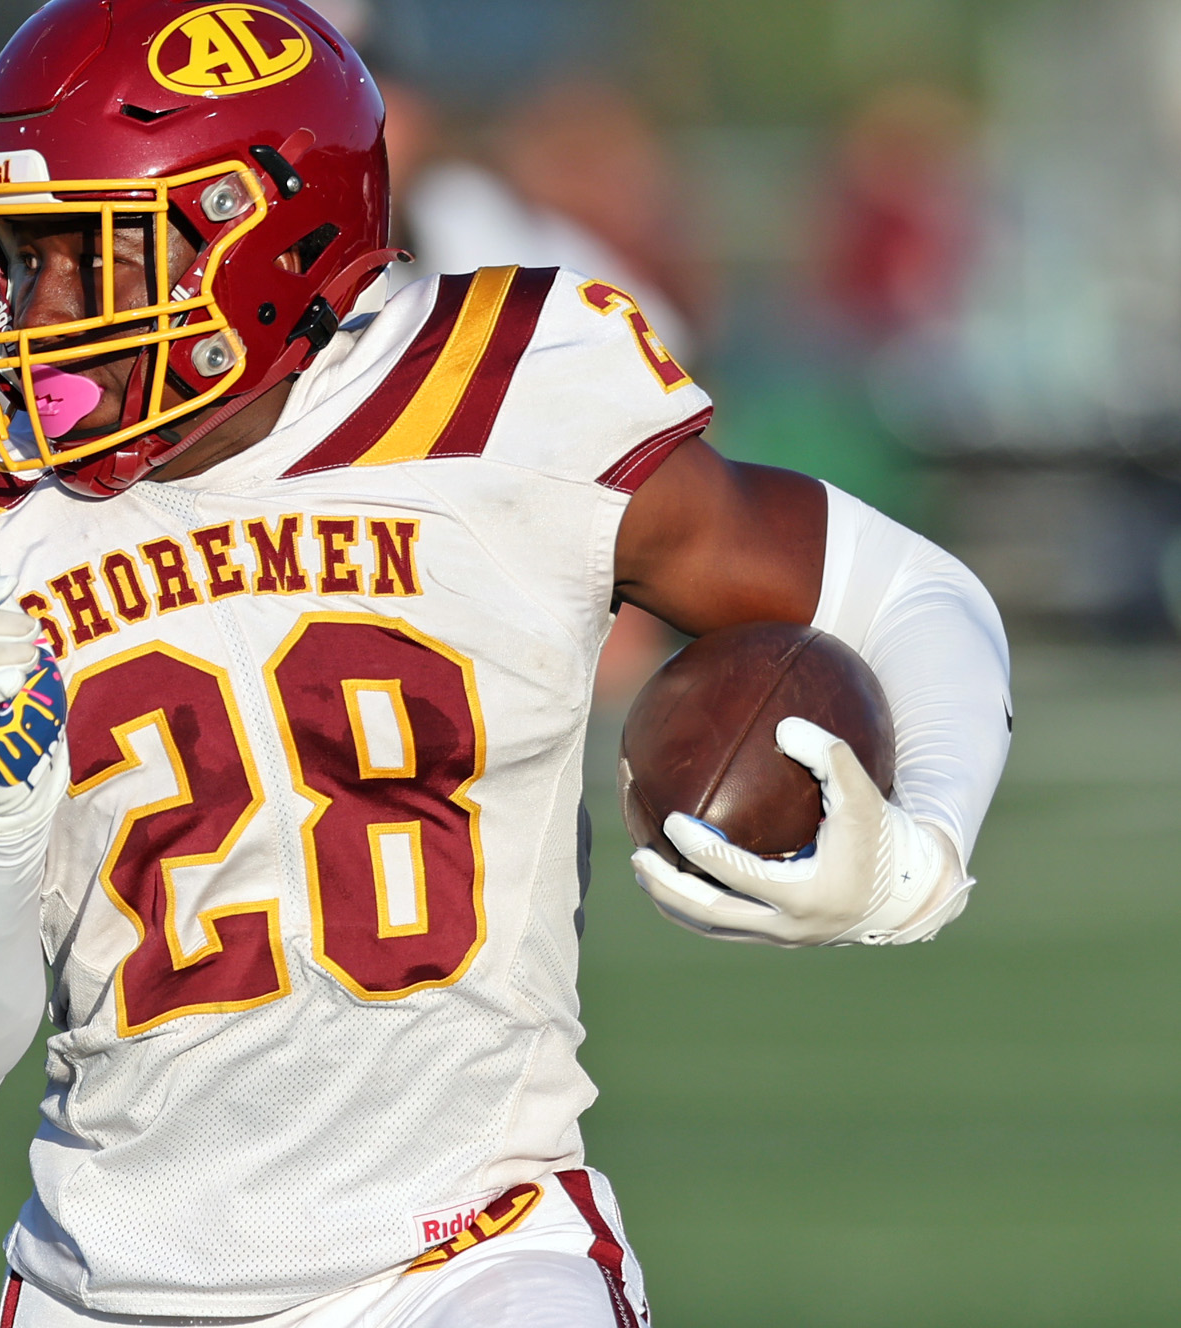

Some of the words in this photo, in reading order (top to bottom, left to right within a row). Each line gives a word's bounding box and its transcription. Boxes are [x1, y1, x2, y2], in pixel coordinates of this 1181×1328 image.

[166, 10, 303, 86] AL
[17, 512, 424, 662] SHOREMEN
[67, 610, 488, 1038] 28
[422, 1208, 476, 1243] Ridd
